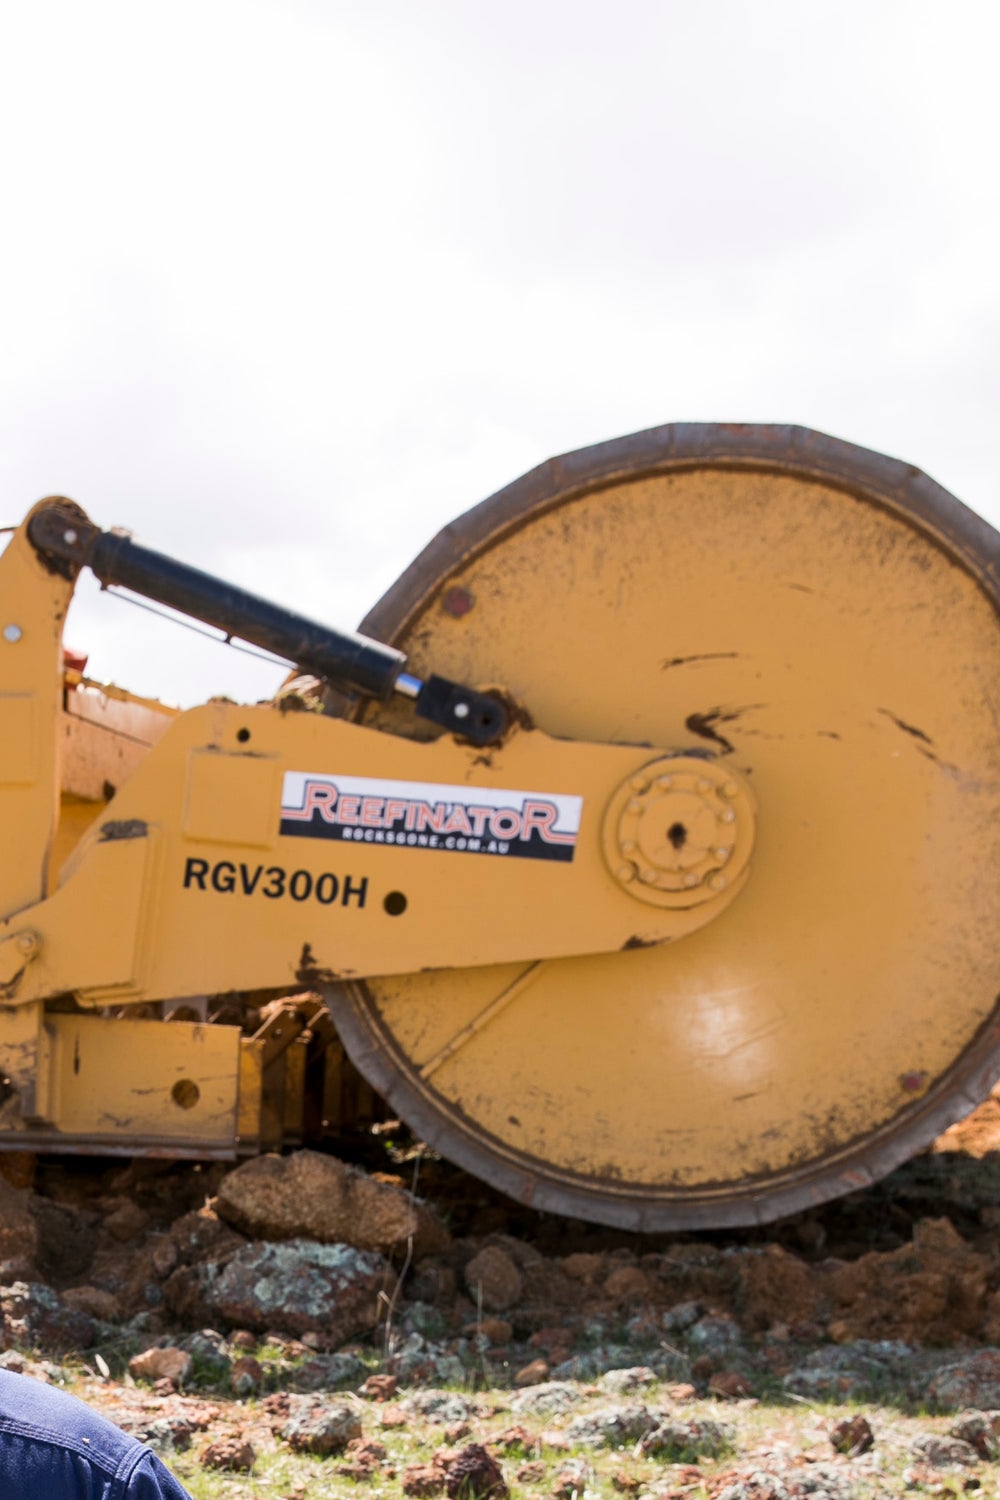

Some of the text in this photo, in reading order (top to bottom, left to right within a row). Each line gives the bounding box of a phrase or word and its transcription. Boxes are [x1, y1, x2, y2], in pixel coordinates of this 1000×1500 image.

[302, 779, 560, 843] REEFINATOR
[342, 827, 510, 855] ROCKSGONE.COM.AU
[183, 857, 369, 909] RGV300H
